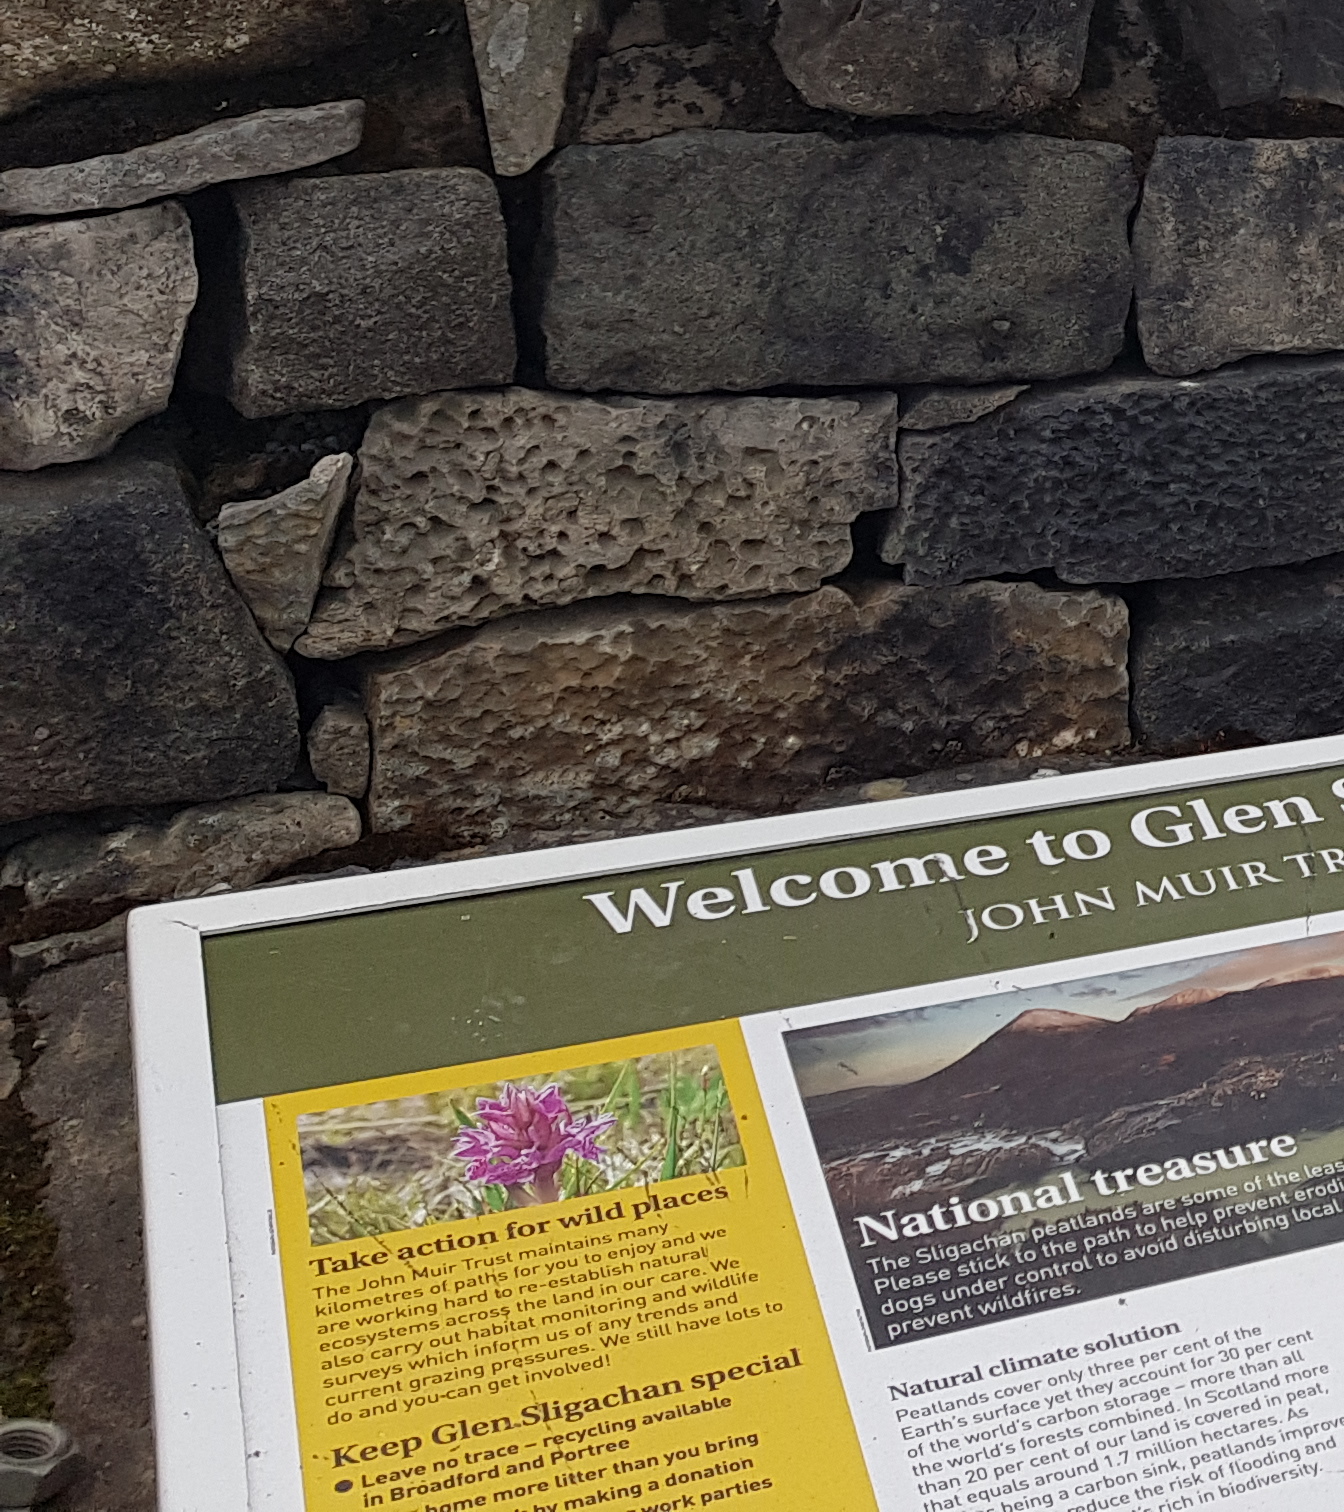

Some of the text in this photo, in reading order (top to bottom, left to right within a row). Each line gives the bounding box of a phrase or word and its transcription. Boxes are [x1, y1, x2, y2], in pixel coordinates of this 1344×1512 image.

[582, 844, 1010, 934] Welcome
[1025, 828, 1112, 866] to
[1130, 793, 1325, 849] Glen
[961, 885, 1117, 945] JOHN
[1135, 860, 1284, 908] MUIR
[307, 1180, 731, 1278] Take action for wild places
[852, 1134, 1298, 1248] National treasure
[865, 1255, 911, 1275] The
[914, 1225, 1026, 1264] Sligachan
[1024, 1199, 1137, 1244] peatlands
[1141, 1197, 1177, 1215] are
[1180, 1185, 1238, 1207] some
[1243, 1174, 1262, 1193] of
[1266, 1170, 1303, 1188] the
[311, 1222, 669, 1300] The John Muir Trust maintains many
[314, 1228, 727, 1318] kilometres of paths for you to enjoy and we
[316, 1245, 709, 1335] are working hard to re-establish natural
[873, 1267, 951, 1295] Please
[956, 1249, 1011, 1277] stick
[1013, 1245, 1037, 1264] to
[1040, 1239, 1078, 1258] the
[1082, 1225, 1131, 1254] path
[1134, 1222, 1157, 1237] to
[1159, 1209, 1208, 1236] help
[1212, 1190, 1291, 1224] prevent
[880, 1292, 937, 1316] dogs
[941, 1275, 1008, 1302] under
[1014, 1253, 1093, 1286] control
[1095, 1252, 1118, 1267] to
[1122, 1233, 1179, 1261] avoid
[1183, 1213, 1290, 1247] disturbing
[1291, 1197, 1343, 1222] local
[886, 1303, 974, 1341] prevent
[976, 1282, 1082, 1316] wildfires.
[329, 1346, 804, 1469] Keep Glen Sligachan special
[886, 1322, 1182, 1402] Natural climate solution
[894, 1326, 1262, 1423] Peatlands cover only three per cent of the
[900, 1329, 1314, 1441] Earth's surface yet they account for 30 per cent
[360, 1464, 427, 1489] Leave
[432, 1457, 459, 1473] no
[463, 1444, 519, 1465] trace
[542, 1417, 637, 1450] recycling
[641, 1396, 732, 1426] available
[362, 1438, 630, 1508] in Broadford and Portree
